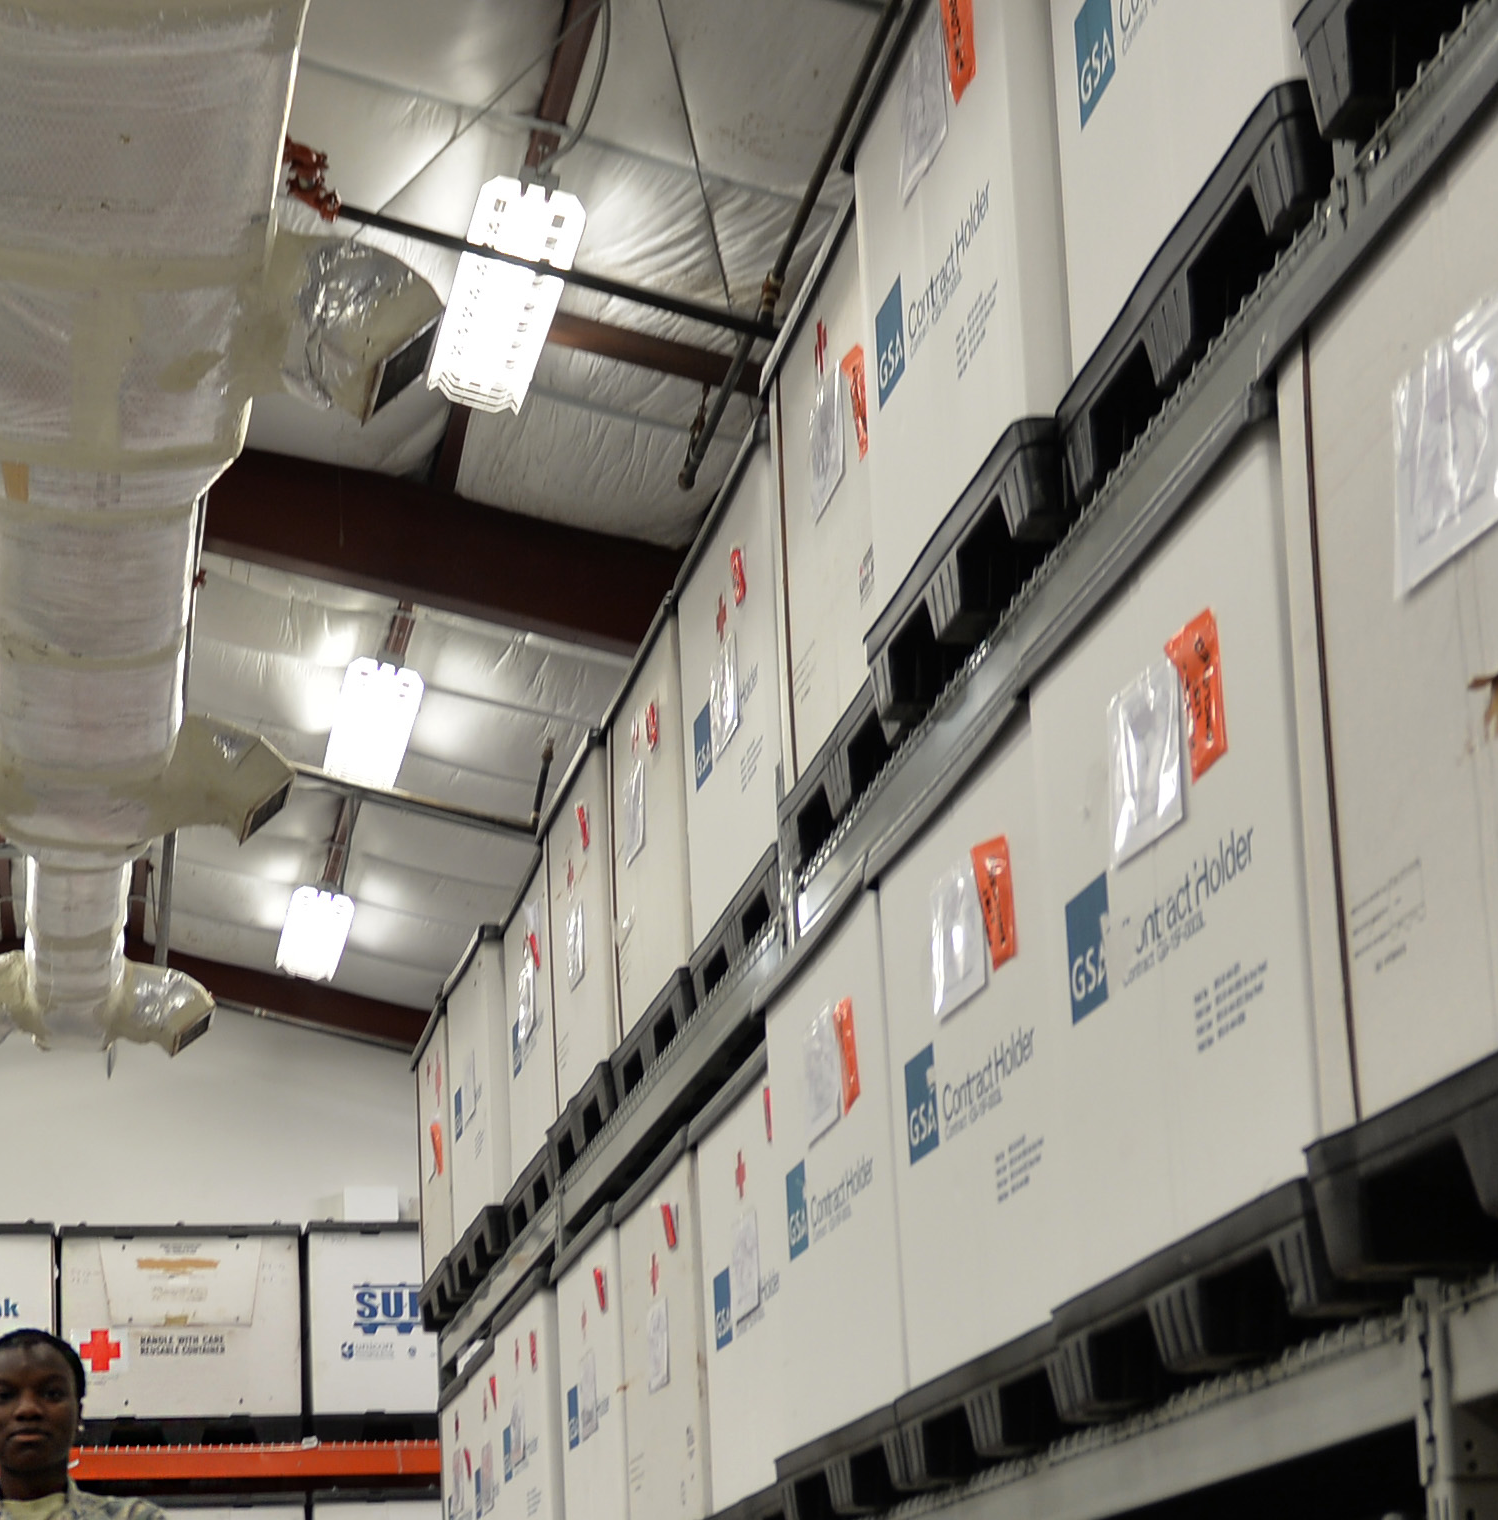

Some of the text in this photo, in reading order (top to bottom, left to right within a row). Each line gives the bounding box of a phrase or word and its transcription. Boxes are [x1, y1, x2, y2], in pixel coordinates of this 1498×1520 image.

[1081, 27, 1112, 105] GSA
[907, 242, 954, 340] Contract
[955, 178, 990, 258] Holder
[879, 328, 904, 390] GSA
[1122, 827, 1254, 955] ntact Holder
[942, 1026, 1035, 1122] Contract Holder
[909, 1097, 937, 1147] GSA
[140, 1334, 225, 1345] HANDLE WITH CARE
[181, 1344, 226, 1355] CONTAINER
